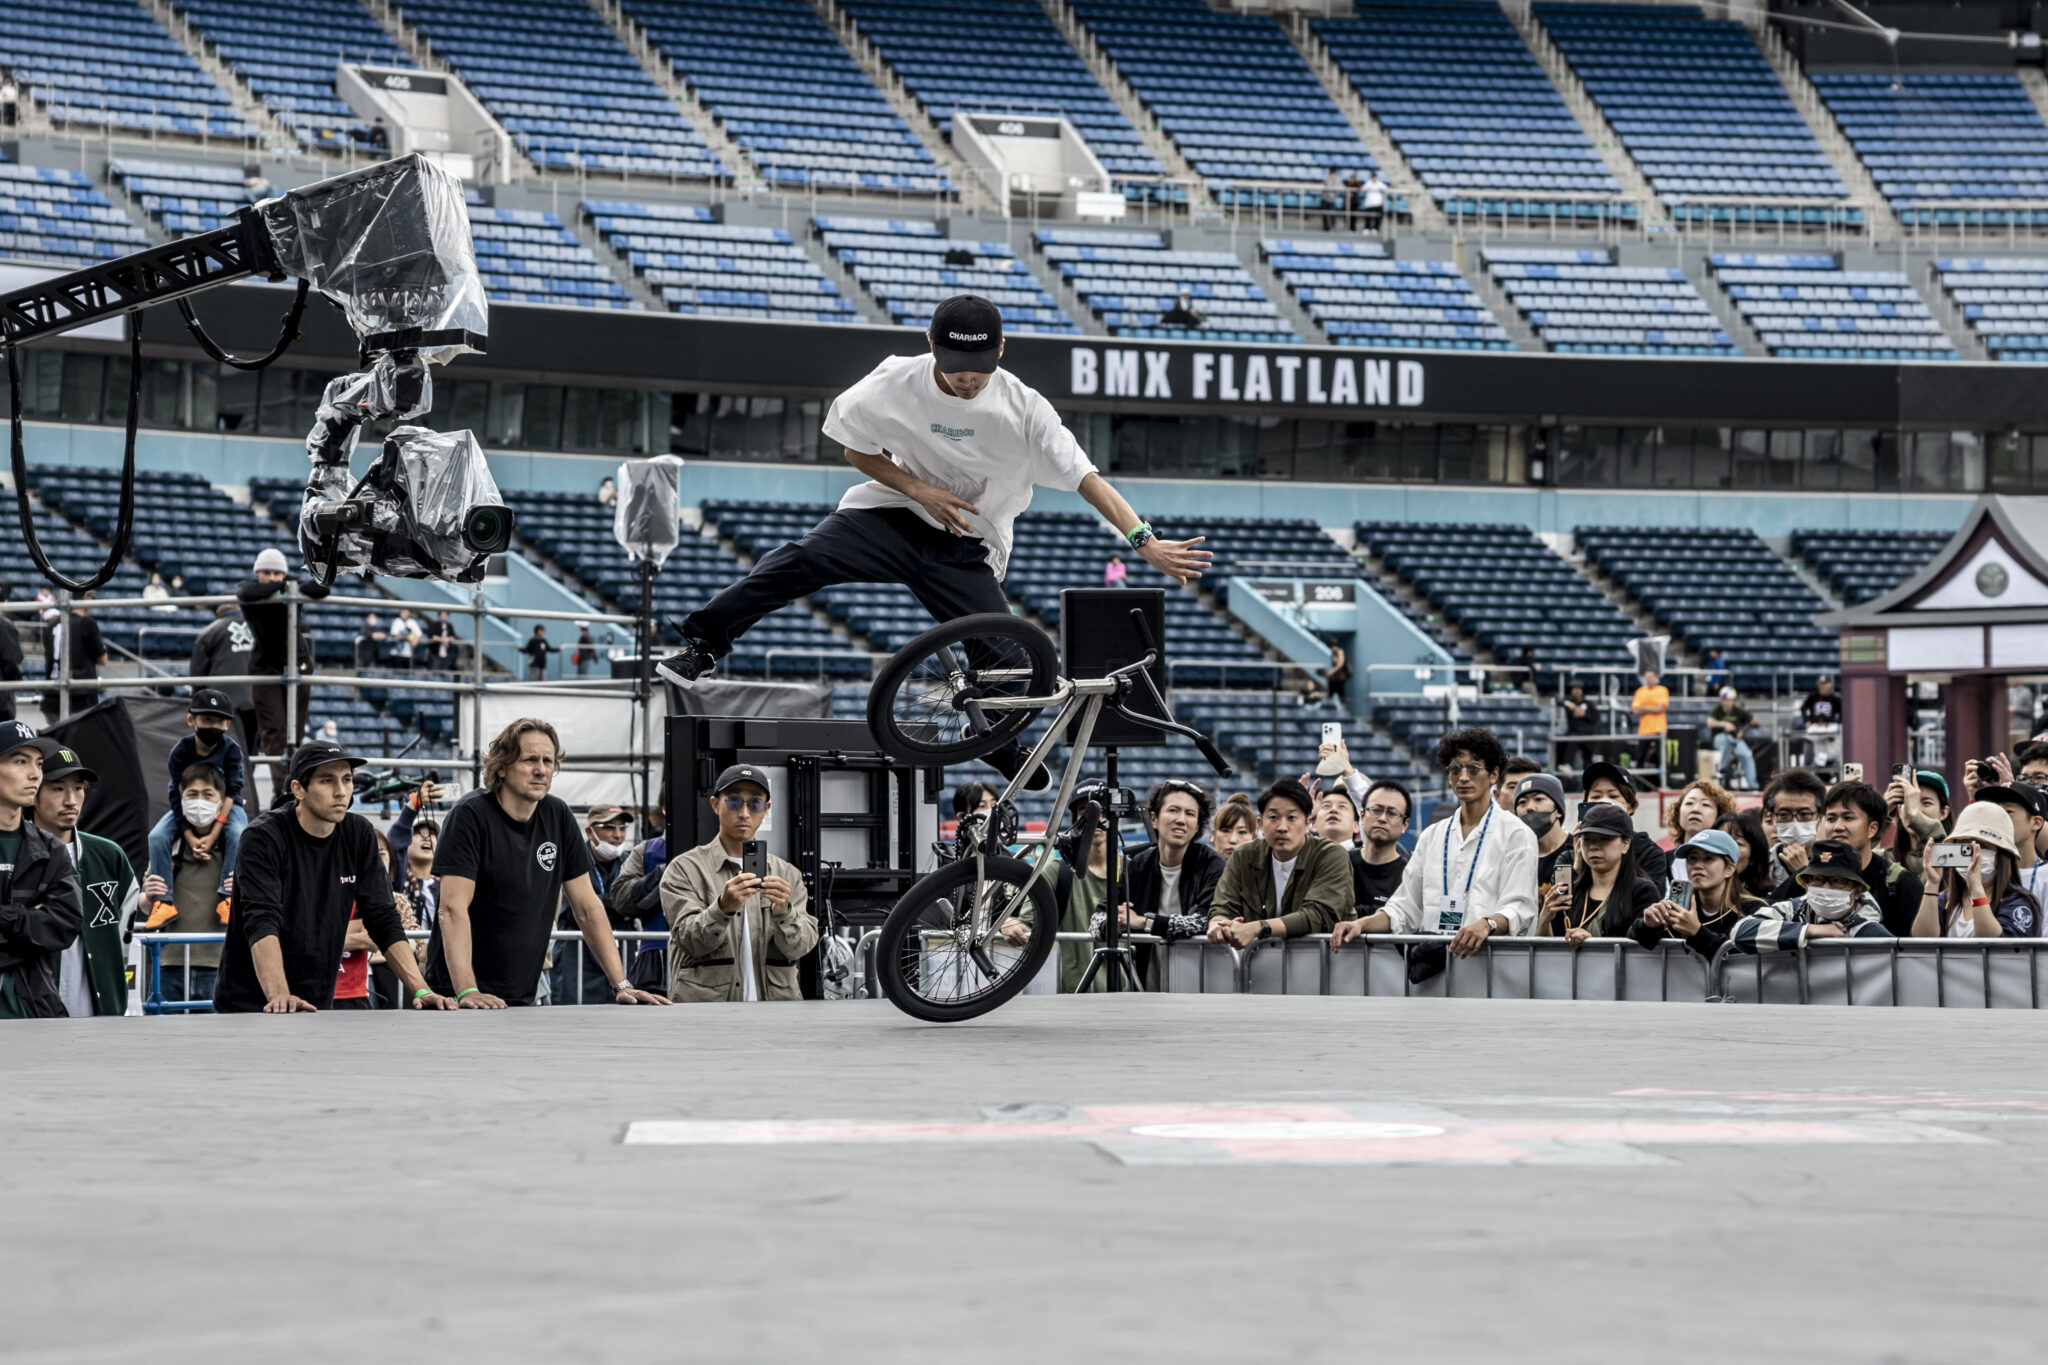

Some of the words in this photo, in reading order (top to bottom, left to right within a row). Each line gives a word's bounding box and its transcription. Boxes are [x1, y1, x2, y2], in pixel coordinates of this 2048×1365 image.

[948, 331, 988, 342] CHARI&CO
[1071, 347, 1172, 399] BMX
[1192, 352, 1425, 407] FLATLAND
[86, 881, 119, 928] X
